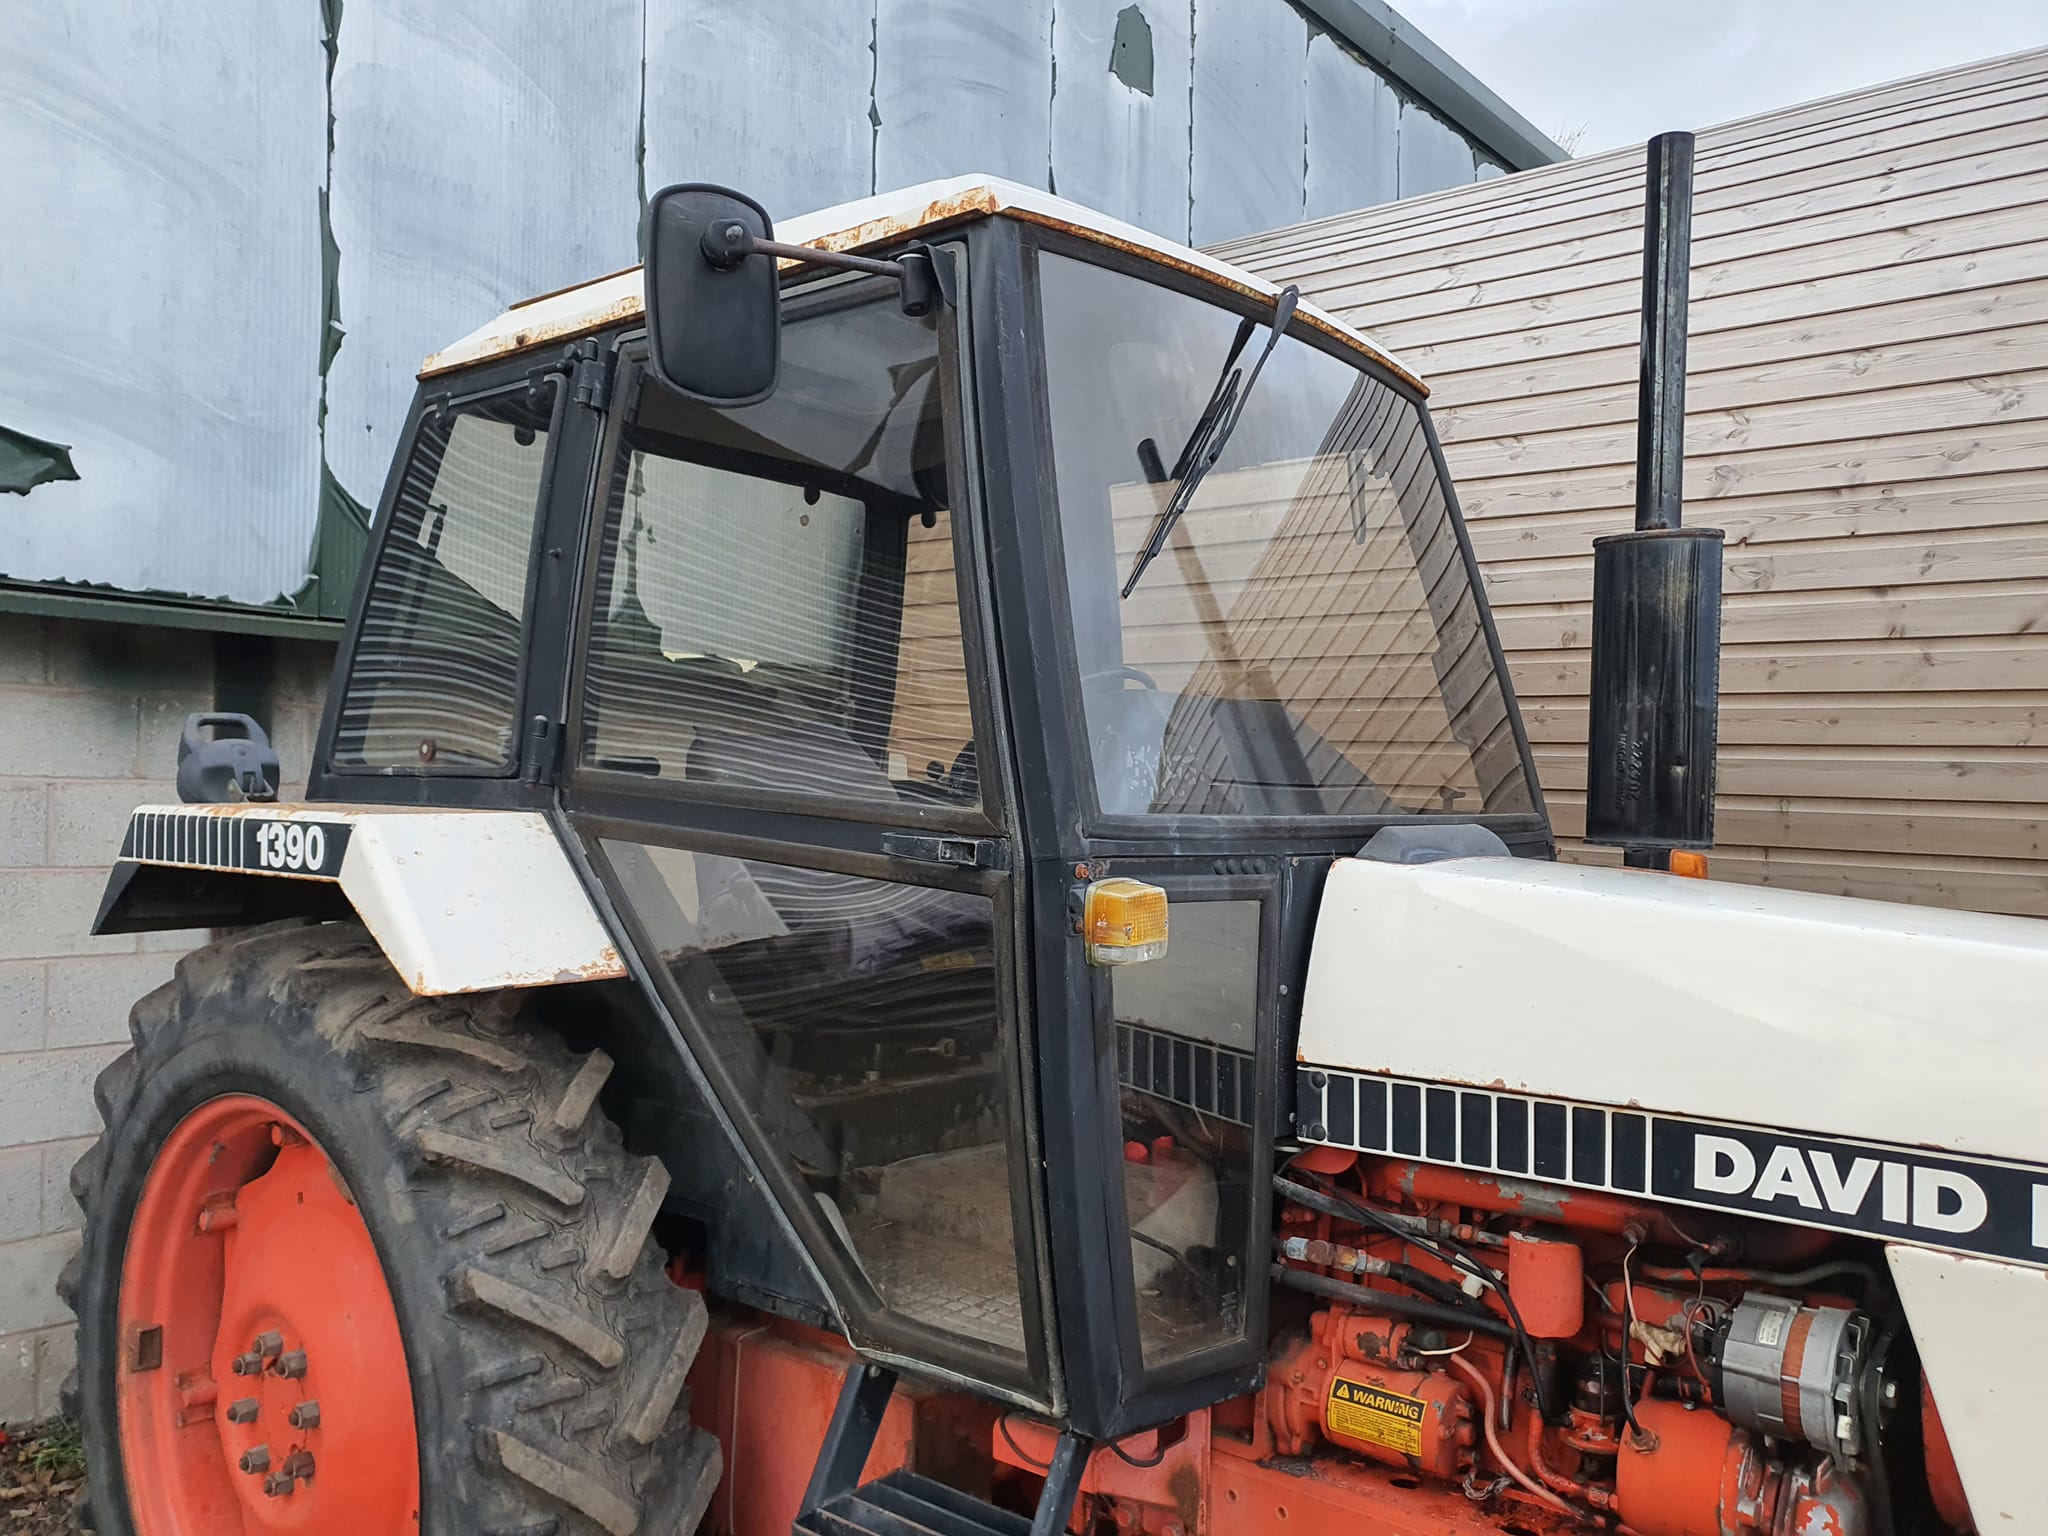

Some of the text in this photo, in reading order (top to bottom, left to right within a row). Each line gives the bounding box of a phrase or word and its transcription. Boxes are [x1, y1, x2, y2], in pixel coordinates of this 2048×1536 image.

[256, 823, 325, 871] 1390
[1693, 1133, 1989, 1234] DAVID
[1353, 1389, 1420, 1419] WARNING
